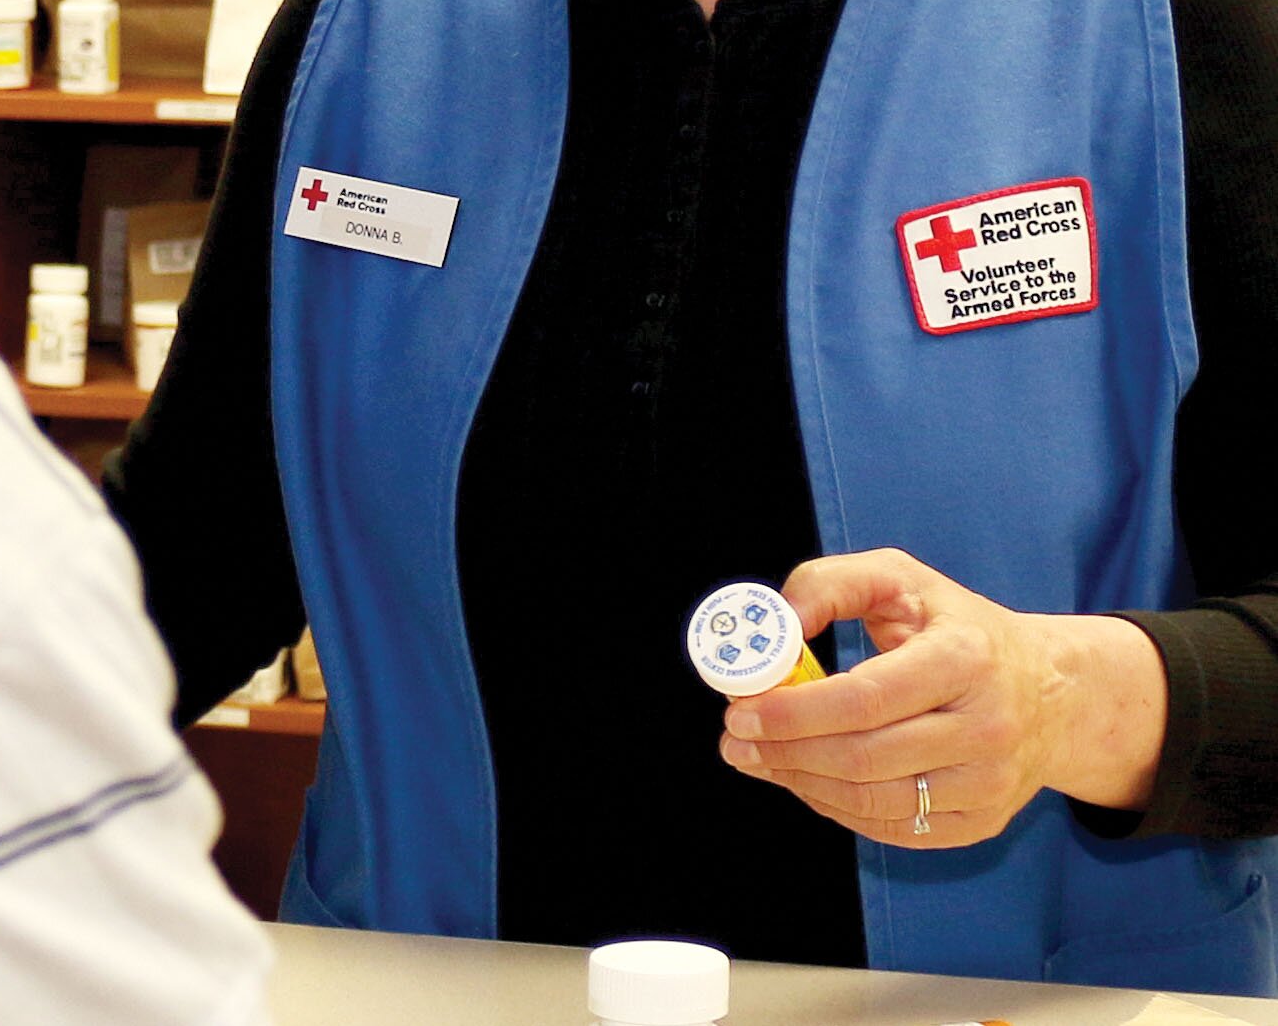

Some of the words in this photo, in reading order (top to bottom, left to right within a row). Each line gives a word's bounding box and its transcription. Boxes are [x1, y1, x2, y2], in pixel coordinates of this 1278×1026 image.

[337, 197, 356, 210] Red
[357, 201, 386, 215] Cross
[339, 188, 388, 205] American
[979, 200, 1077, 228] American
[345, 221, 388, 241] DONNA
[392, 231, 403, 245] B.
[981, 224, 1022, 246] Red
[1027, 216, 1081, 238] Cross
[960, 257, 1056, 284] Volunteer
[944, 276, 1021, 305] Service
[1024, 273, 1044, 289] to
[1048, 269, 1076, 284] the
[951, 294, 1015, 320] Armed
[1020, 287, 1076, 306] Forces
